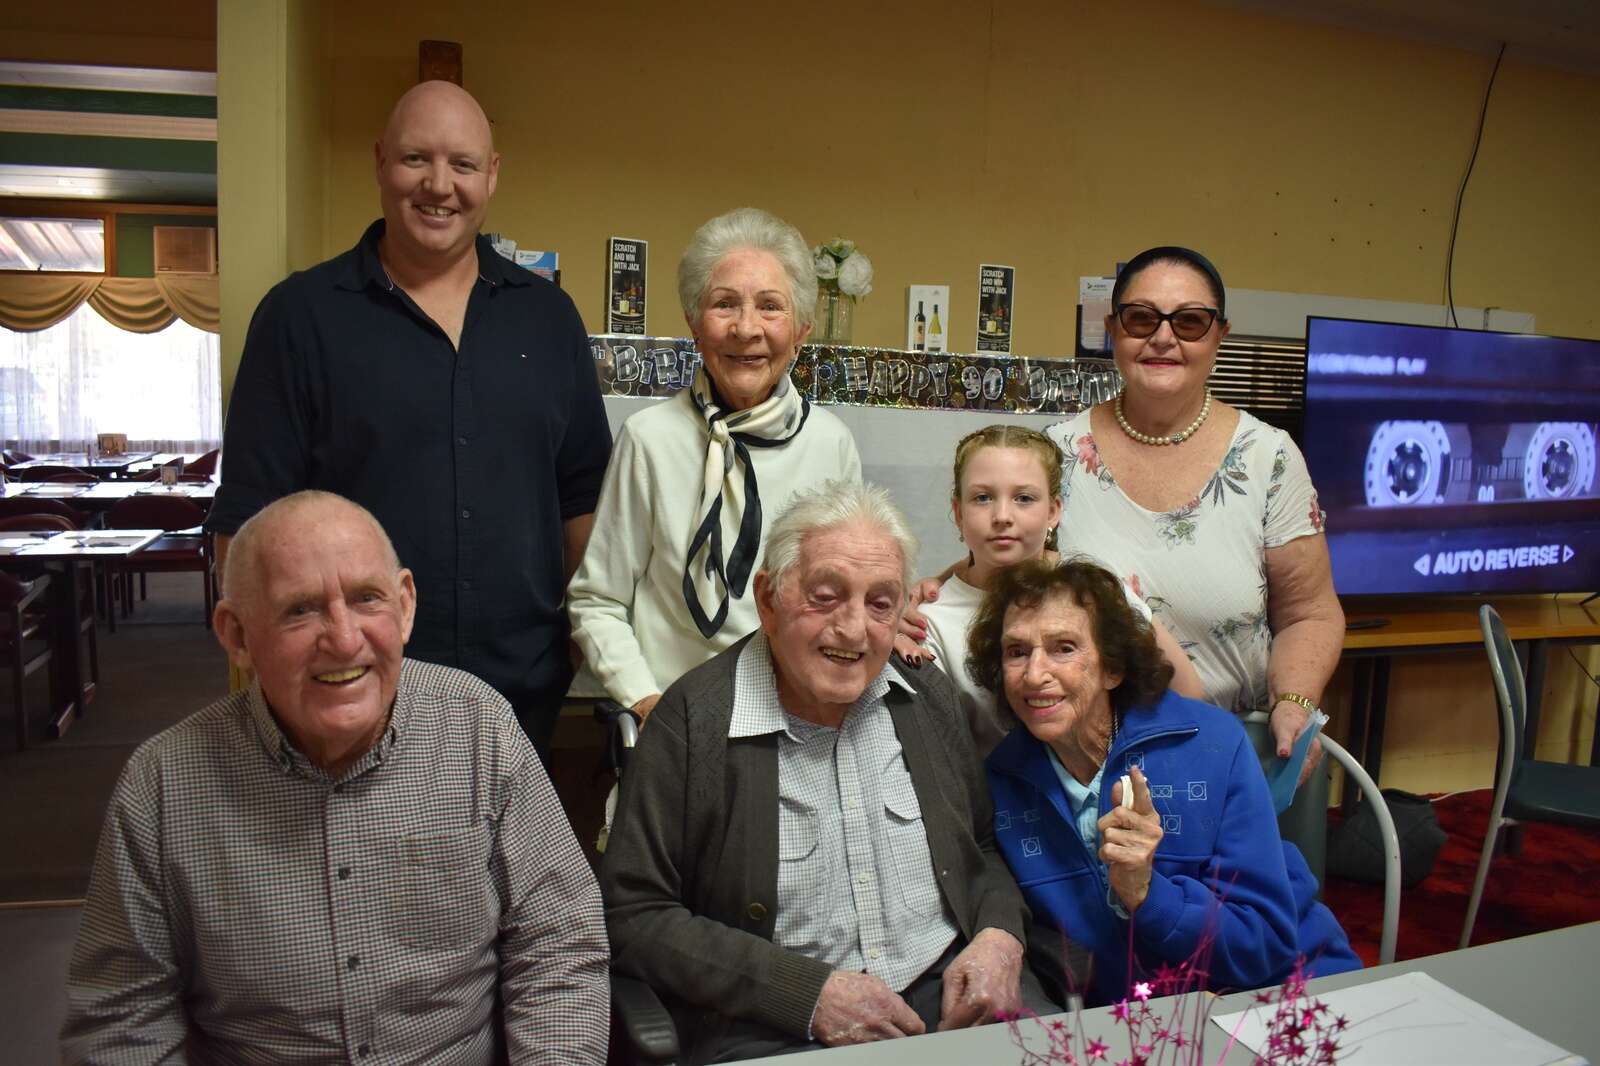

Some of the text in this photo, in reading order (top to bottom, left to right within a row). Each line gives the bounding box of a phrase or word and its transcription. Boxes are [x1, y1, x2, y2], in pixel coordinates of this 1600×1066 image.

[614, 243, 637, 253] SCRATCH
[614, 252, 625, 261] AND
[614, 261, 640, 271] WITH JACK
[982, 269, 1005, 278] SCRATCH
[843, 356, 949, 398] HAPPY
[1433, 544, 1561, 576] AUTO REVERSE
